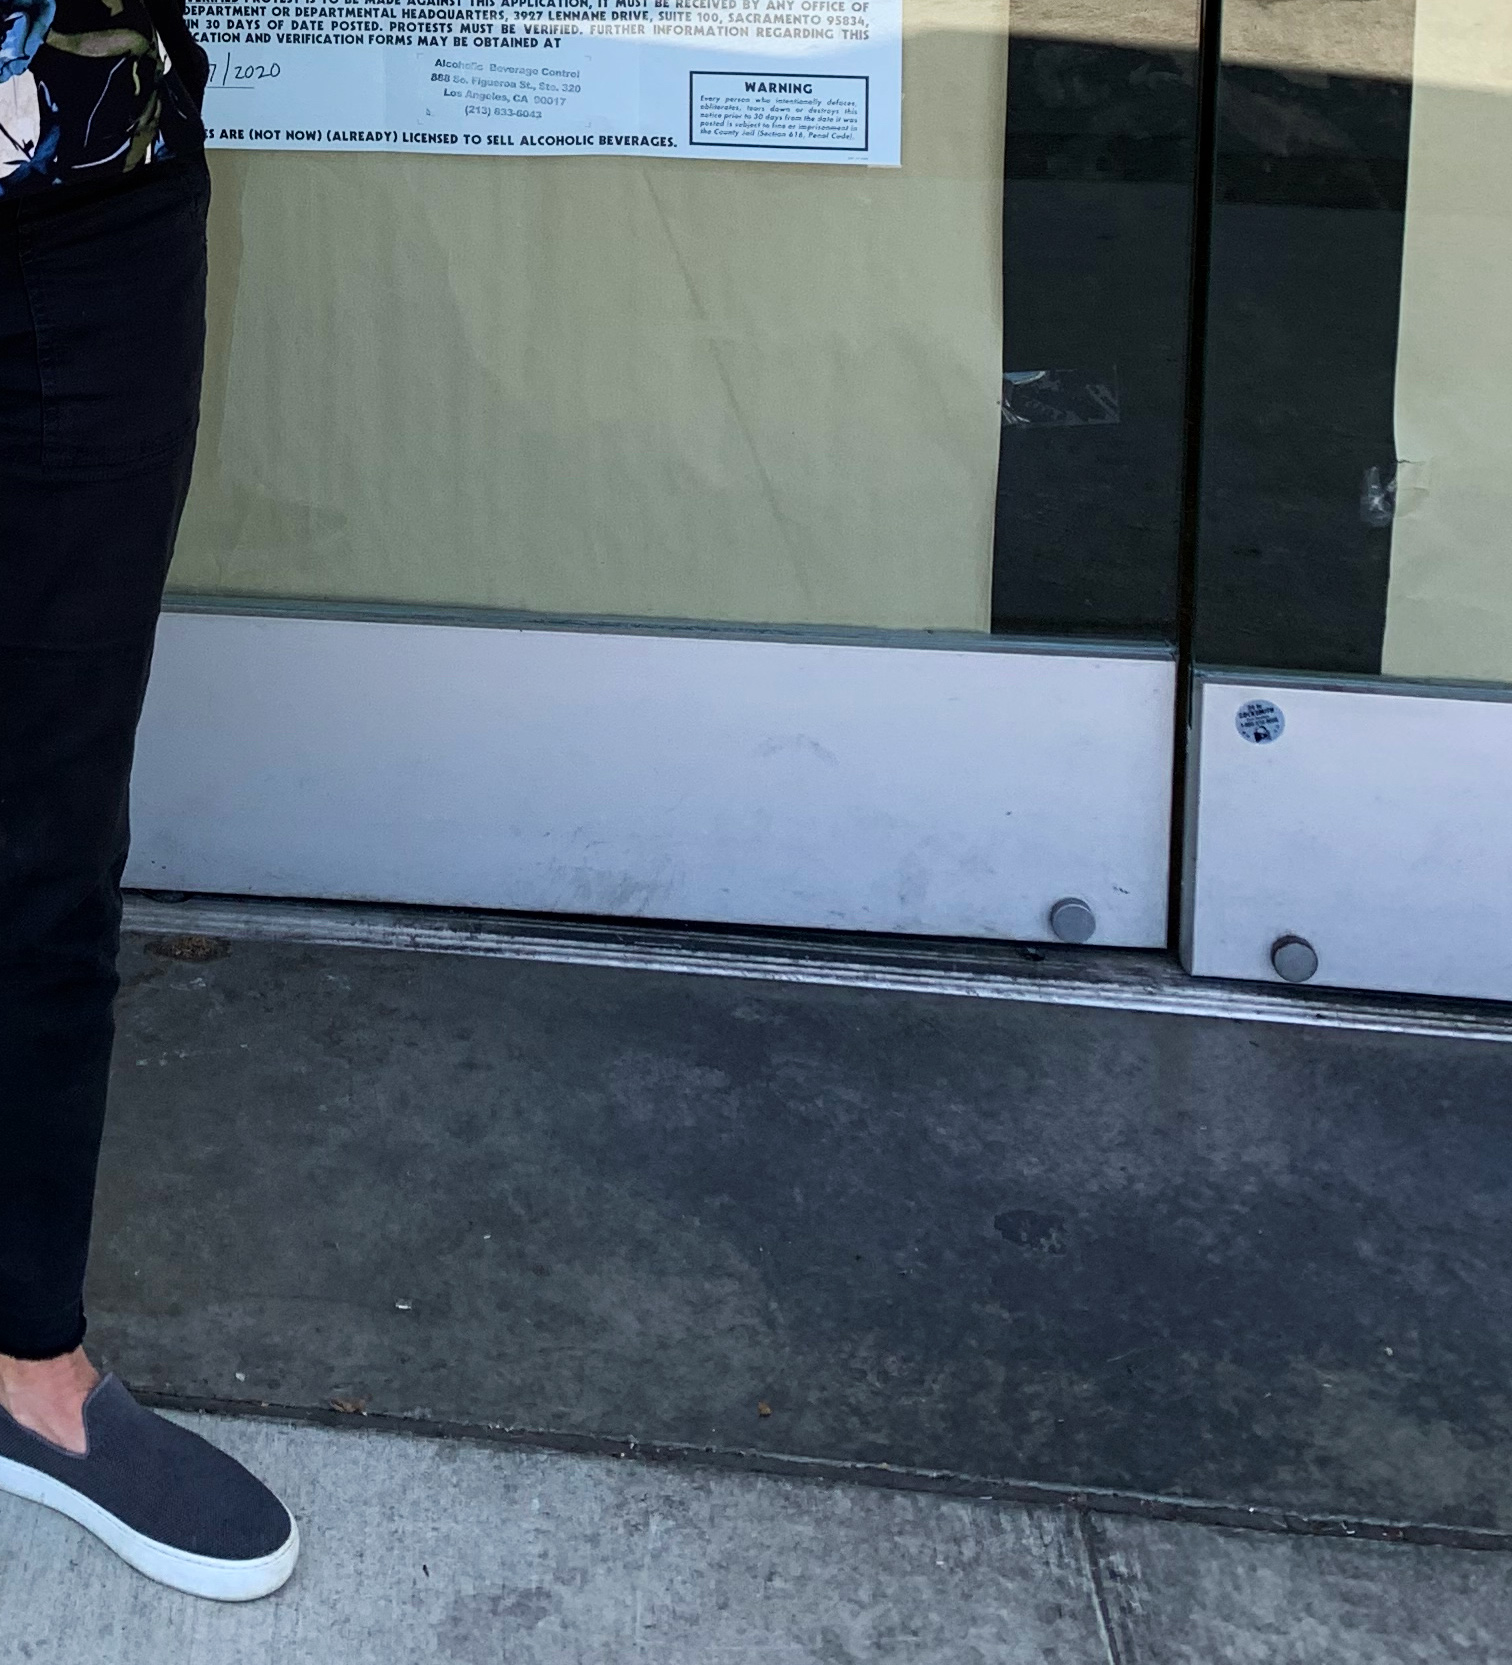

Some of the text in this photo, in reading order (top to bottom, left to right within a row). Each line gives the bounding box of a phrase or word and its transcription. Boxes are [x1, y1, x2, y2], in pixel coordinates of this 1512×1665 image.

[742, 0, 761, 11] BY
[766, 0, 795, 12] ANY
[800, 0, 845, 13] OFFICE
[850, 1, 870, 13] OF
[183, 5, 871, 27] DEPARTMENT OR DEPARTMENTAL HEADQUARTERS, 3927 LENNANE DRIVE, SUITE 100, SACRAMENTO 95834,
[205, 19, 221, 30] 30
[226, 19, 261, 31] DAYS
[267, 20, 285, 31] OF
[291, 20, 325, 32] DATE
[330, 21, 384, 33] POSTED.
[389, 22, 453, 33] PROTESTS
[459, 23, 495, 35] MUST
[500, 24, 517, 35] BE
[523, 24, 584, 36] VERIFIED.
[589, 24, 649, 36] FURTHER
[652, 25, 750, 37] INFORMATION
[755, 27, 835, 40] REGARDING
[840, 28, 870, 41] THIS
[245, 33, 562, 49] AND VERIFICATION FORMS MAY BE OBTAINED AT
[434, 58, 580, 79] Alcoholic Beverage Control
[443, 87, 529, 104] Los CA
[561, 83, 581, 93] 320
[744, 81, 813, 95] WARNING
[700, 95, 721, 104] Every
[219, 128, 245, 140] ARE
[249, 128, 282, 141] (NOT
[285, 129, 322, 142] NOW)
[326, 129, 398, 143] (ALREADY)
[402, 131, 459, 144] LICENSED
[463, 133, 482, 145] TO
[486, 133, 516, 146] SELL
[519, 135, 595, 147] ALCOHOLIC
[598, 135, 678, 148] BEVERAGES.
